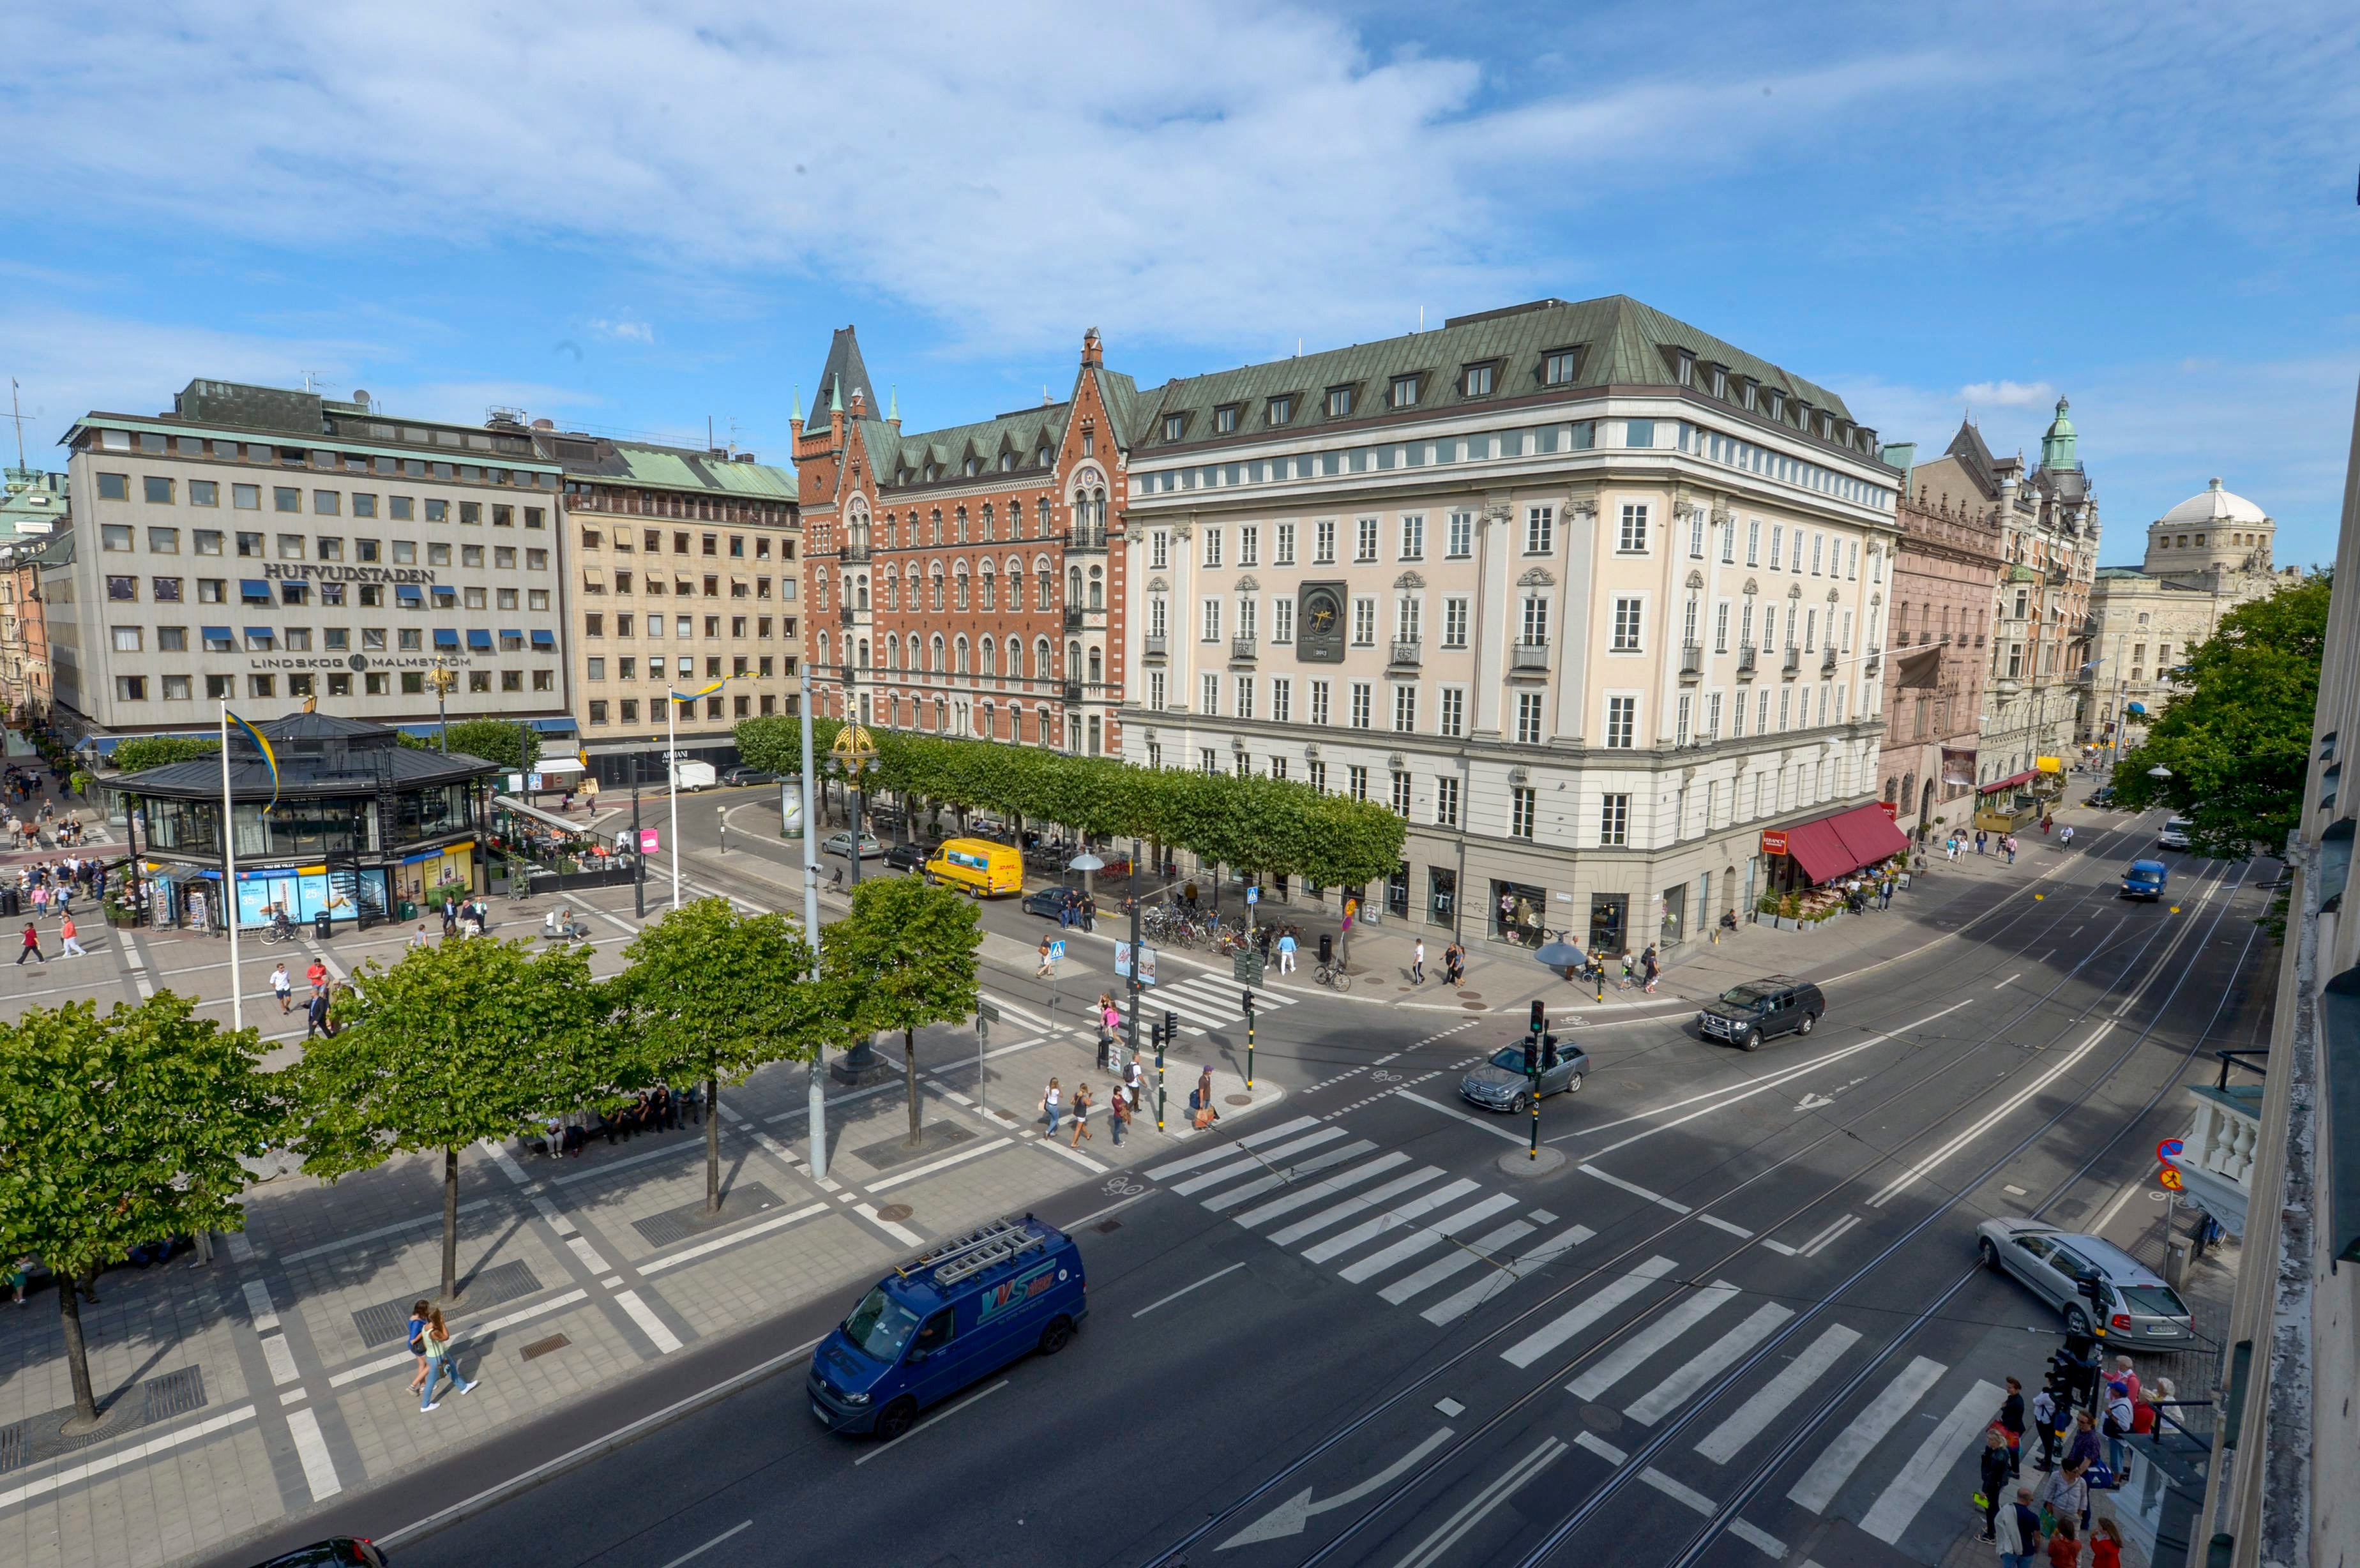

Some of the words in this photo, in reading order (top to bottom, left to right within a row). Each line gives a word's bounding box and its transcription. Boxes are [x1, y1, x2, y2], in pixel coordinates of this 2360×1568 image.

[262, 563, 435, 584] HUFVUDSTADEN
[251, 658, 344, 668] LINDSKOG
[372, 655, 471, 667] MALMSTRÖM
